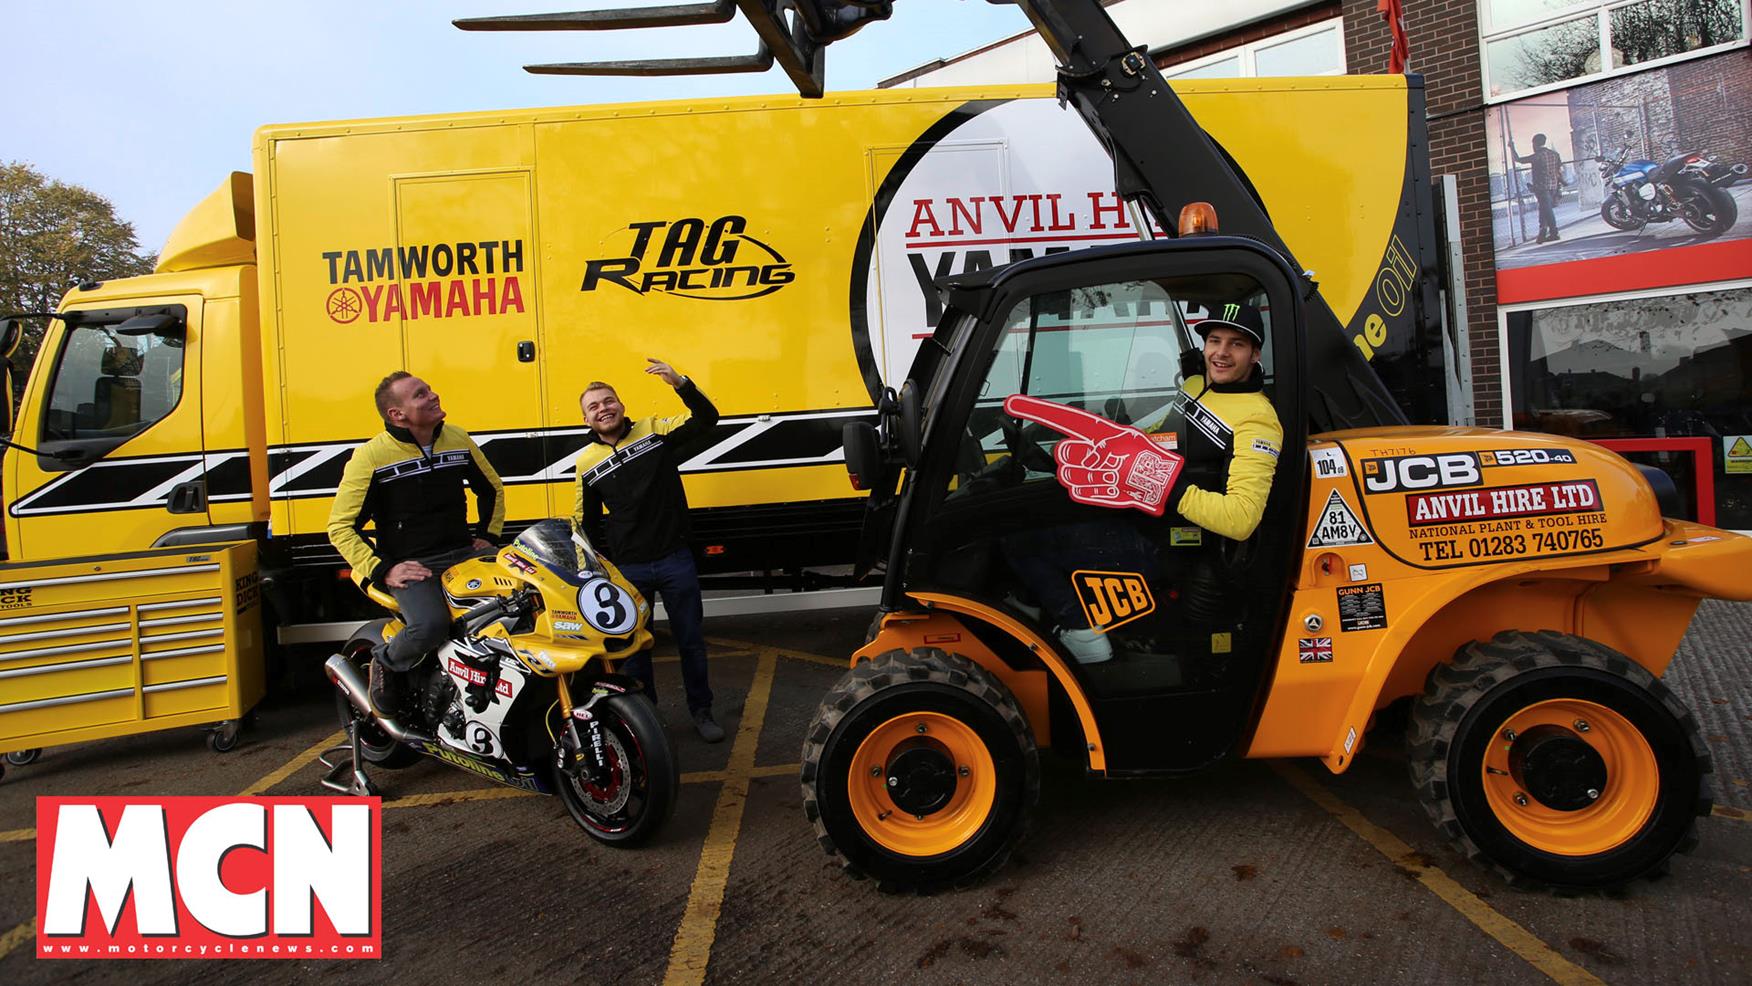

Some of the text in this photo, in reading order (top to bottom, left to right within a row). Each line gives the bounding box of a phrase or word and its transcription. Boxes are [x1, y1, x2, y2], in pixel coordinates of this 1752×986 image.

[905, 193, 1076, 238] ANVIL
[628, 215, 747, 268] TAG
[322, 239, 524, 285] TAMWORTH
[360, 276, 526, 323] YAMAHA
[1199, 414, 1220, 436] YAMAHA
[1317, 458, 1337, 476] 104
[1366, 454, 1480, 492] JCB
[1329, 510, 1347, 525] 81
[1415, 484, 1594, 521] ANVIL HIRE LTD
[1321, 524, 1357, 540] AM8Y
[1408, 513, 1608, 539] NATIONAL PLANT & TOOL HIRE
[1418, 528, 1604, 561] TEL 01283 740765
[0, 586, 33, 595] NG
[0, 594, 33, 604] CK
[594, 582, 627, 629] 3
[1084, 576, 1148, 627] JCB
[1338, 585, 1381, 596] GUNN JCB
[449, 661, 469, 677] Anvil
[470, 670, 487, 684] Hir
[471, 727, 494, 755] 3
[589, 720, 604, 767] PIRELLI
[422, 741, 505, 782] Putoline
